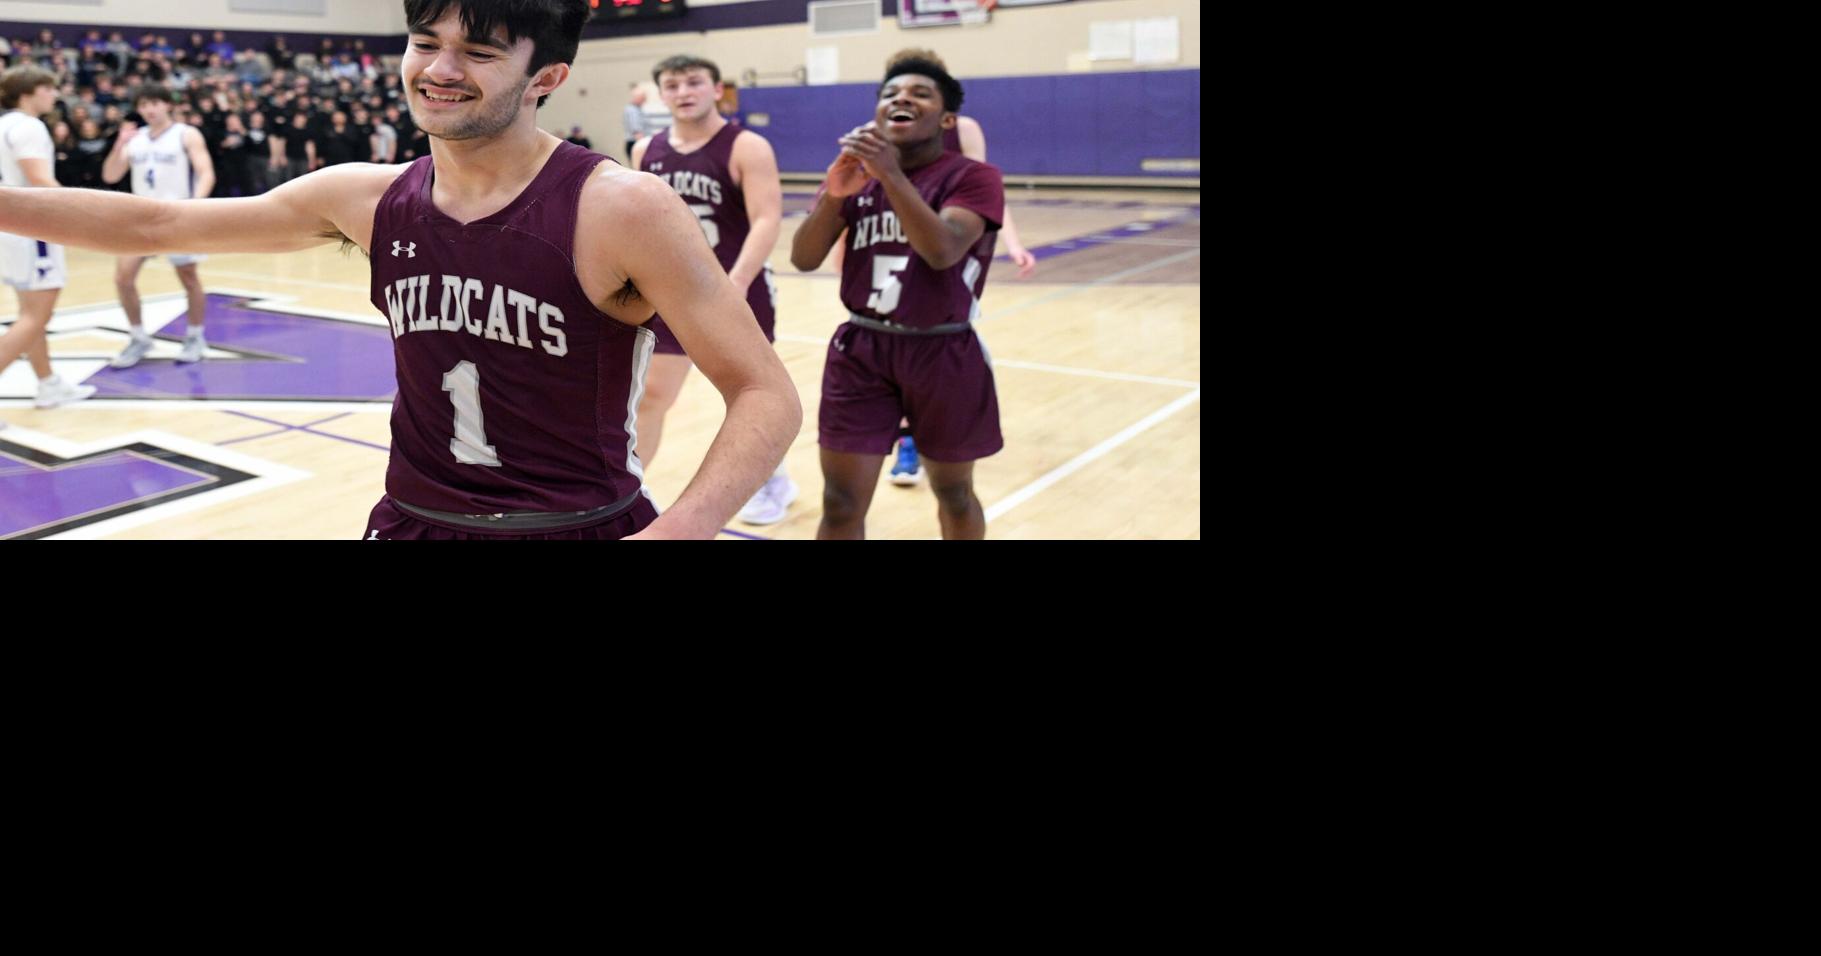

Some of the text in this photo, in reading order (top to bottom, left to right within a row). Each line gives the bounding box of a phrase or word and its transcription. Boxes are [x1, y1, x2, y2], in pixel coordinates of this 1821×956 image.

[384, 274, 568, 357] WILDCATS
[866, 254, 909, 314] 5
[441, 359, 502, 467] 1
